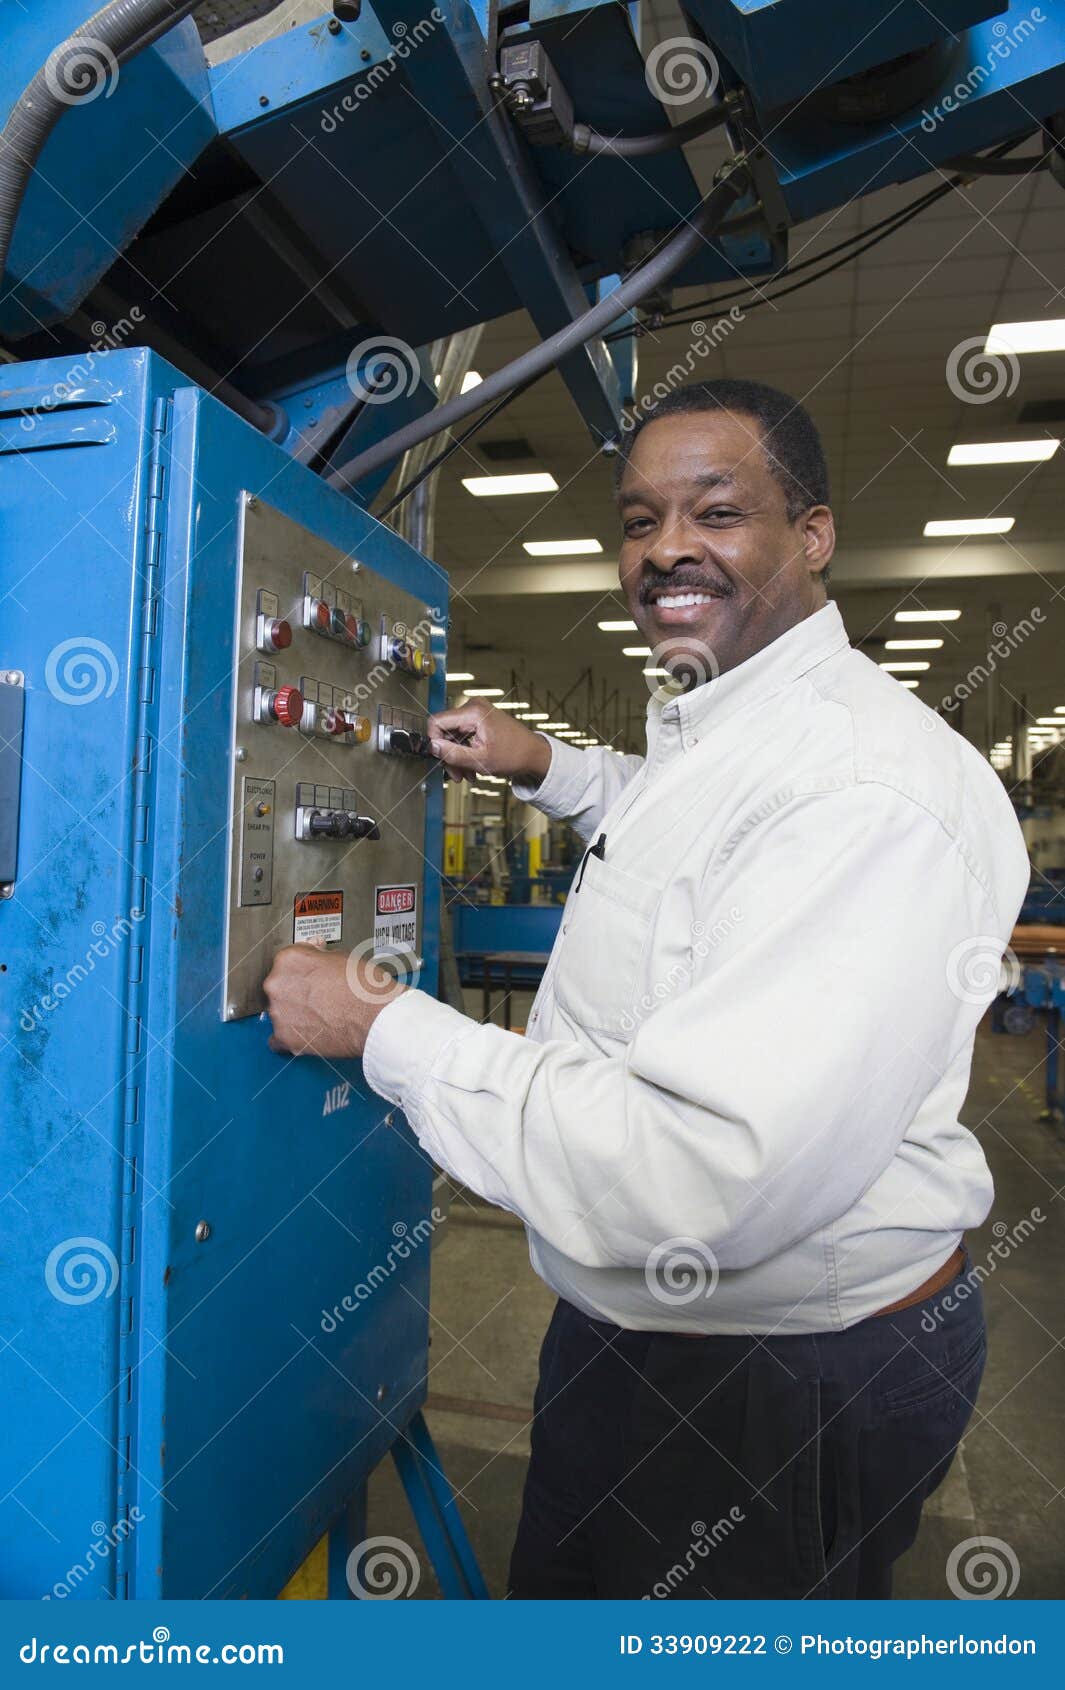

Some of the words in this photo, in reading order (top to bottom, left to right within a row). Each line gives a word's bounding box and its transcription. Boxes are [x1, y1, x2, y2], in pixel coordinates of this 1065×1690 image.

[307, 897, 339, 911] WARNING
[380, 892, 412, 908] DANGER
[376, 927, 390, 948] HIGH
[391, 923, 415, 944] VOLTAGE
